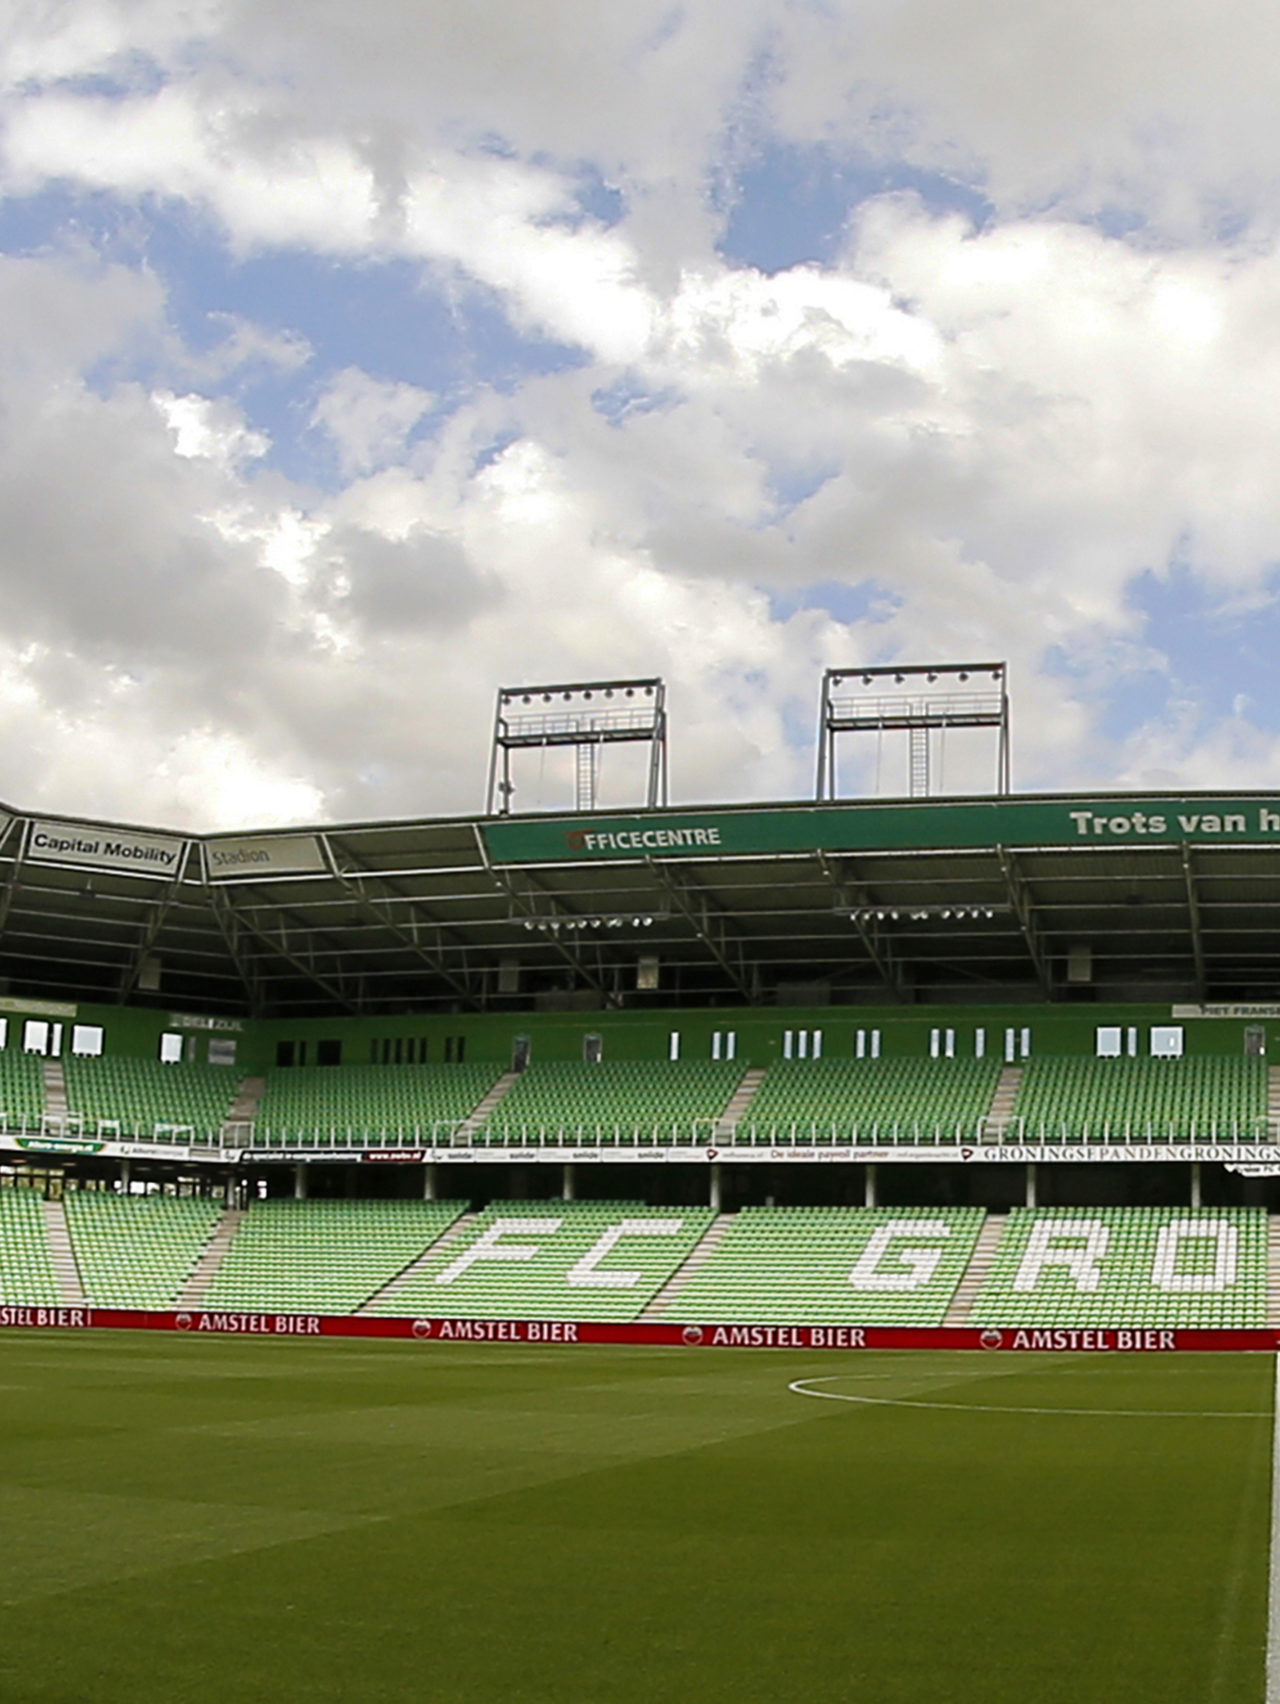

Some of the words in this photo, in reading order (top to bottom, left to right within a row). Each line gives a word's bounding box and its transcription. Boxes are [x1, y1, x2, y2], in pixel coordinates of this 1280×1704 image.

[1070, 811, 1167, 835] Trots
[1179, 814, 1246, 833] van
[34, 833, 100, 854] Capital
[104, 843, 177, 865] Mobility
[771, 1150, 783, 1158] De
[787, 1150, 815, 1158] ideale
[818, 1150, 850, 1160] payroll
[853, 1151, 888, 1160] partner
[434, 1217, 684, 1287] FC
[37, 1308, 84, 1326] BIER
[199, 1313, 270, 1333] AMSTEL
[275, 1314, 321, 1335] BIER
[439, 1319, 521, 1340] AMSTEL
[527, 1321, 578, 1342] BIER
[712, 1327, 803, 1346] AMSTEL
[810, 1328, 866, 1347] BIER
[1012, 1330, 1109, 1349] AMSTEL
[1117, 1330, 1176, 1350] BIER
